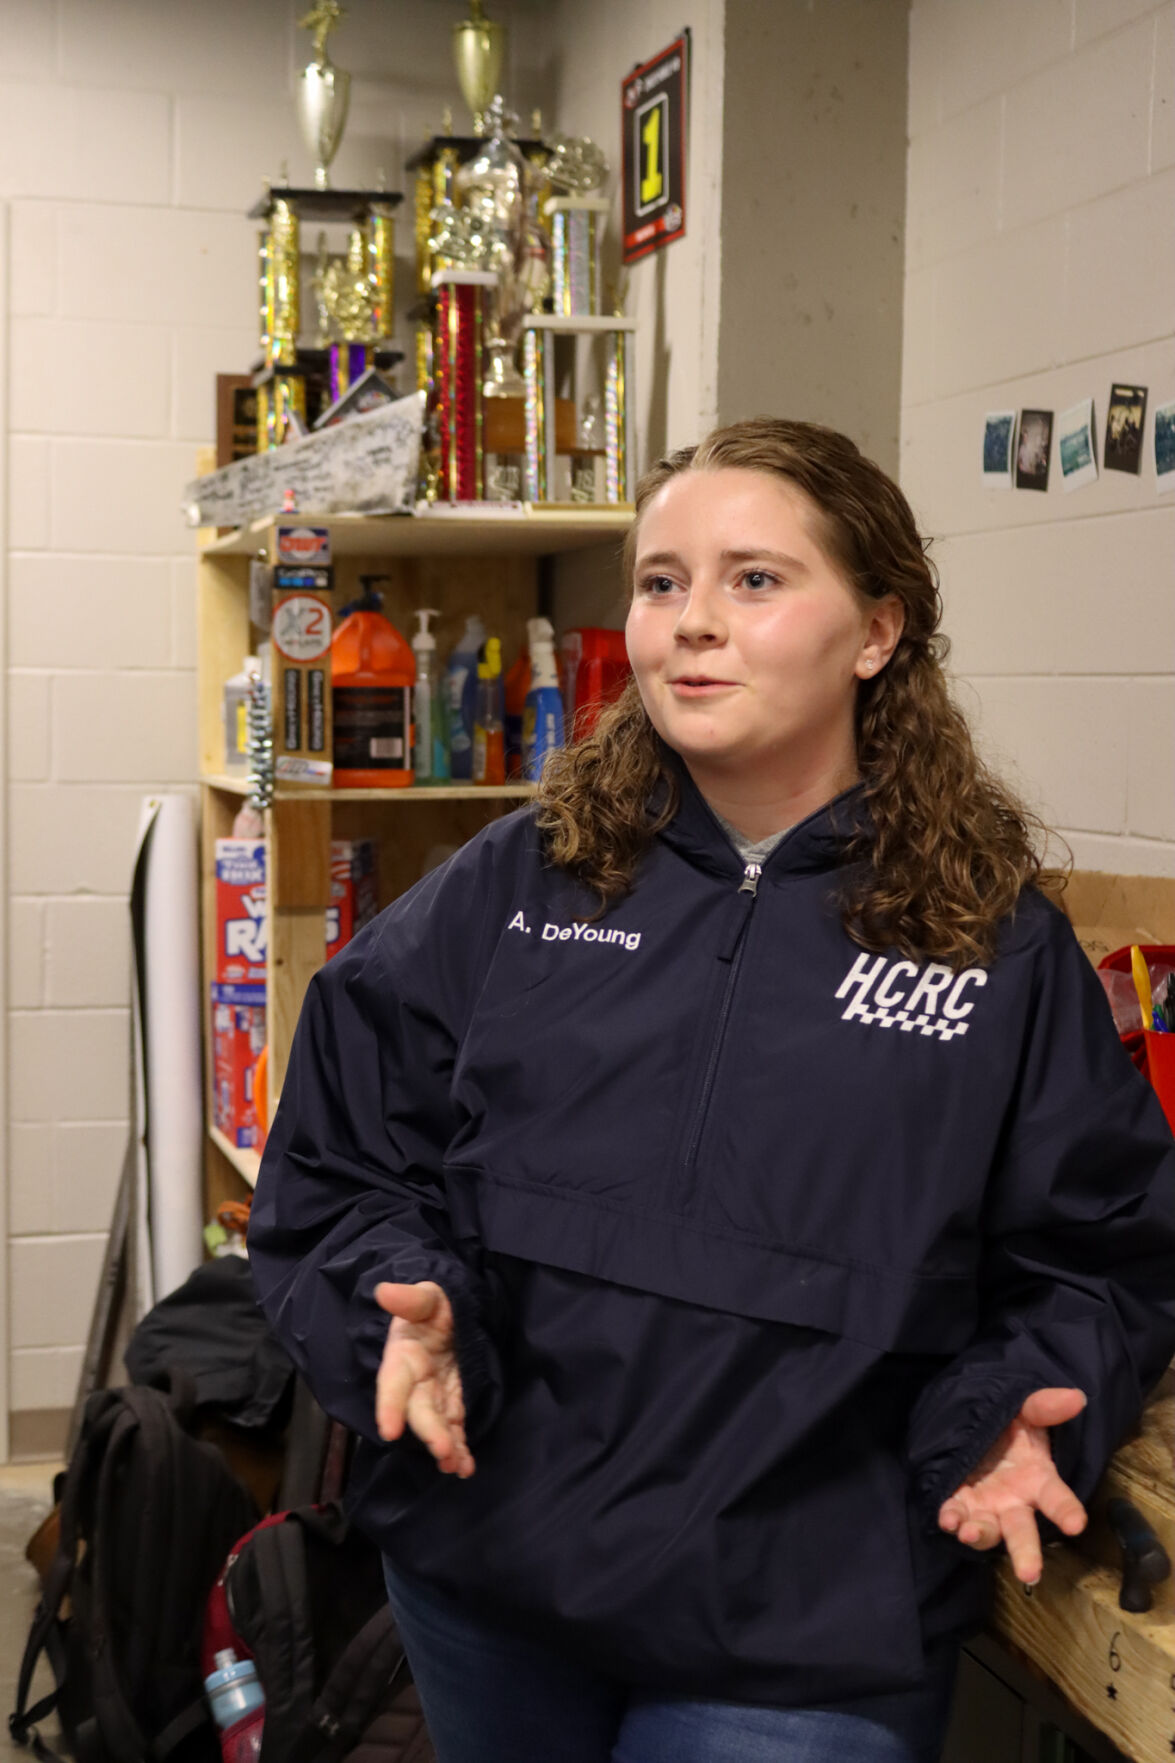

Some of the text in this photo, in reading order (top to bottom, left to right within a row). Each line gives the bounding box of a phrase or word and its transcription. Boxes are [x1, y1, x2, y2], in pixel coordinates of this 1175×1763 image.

[641, 107, 662, 203] 1
[280, 607, 325, 636] X2
[508, 910, 642, 951] A. DeYoung
[835, 952, 989, 1020] HCRC
[1109, 1631, 1122, 1672] 6
